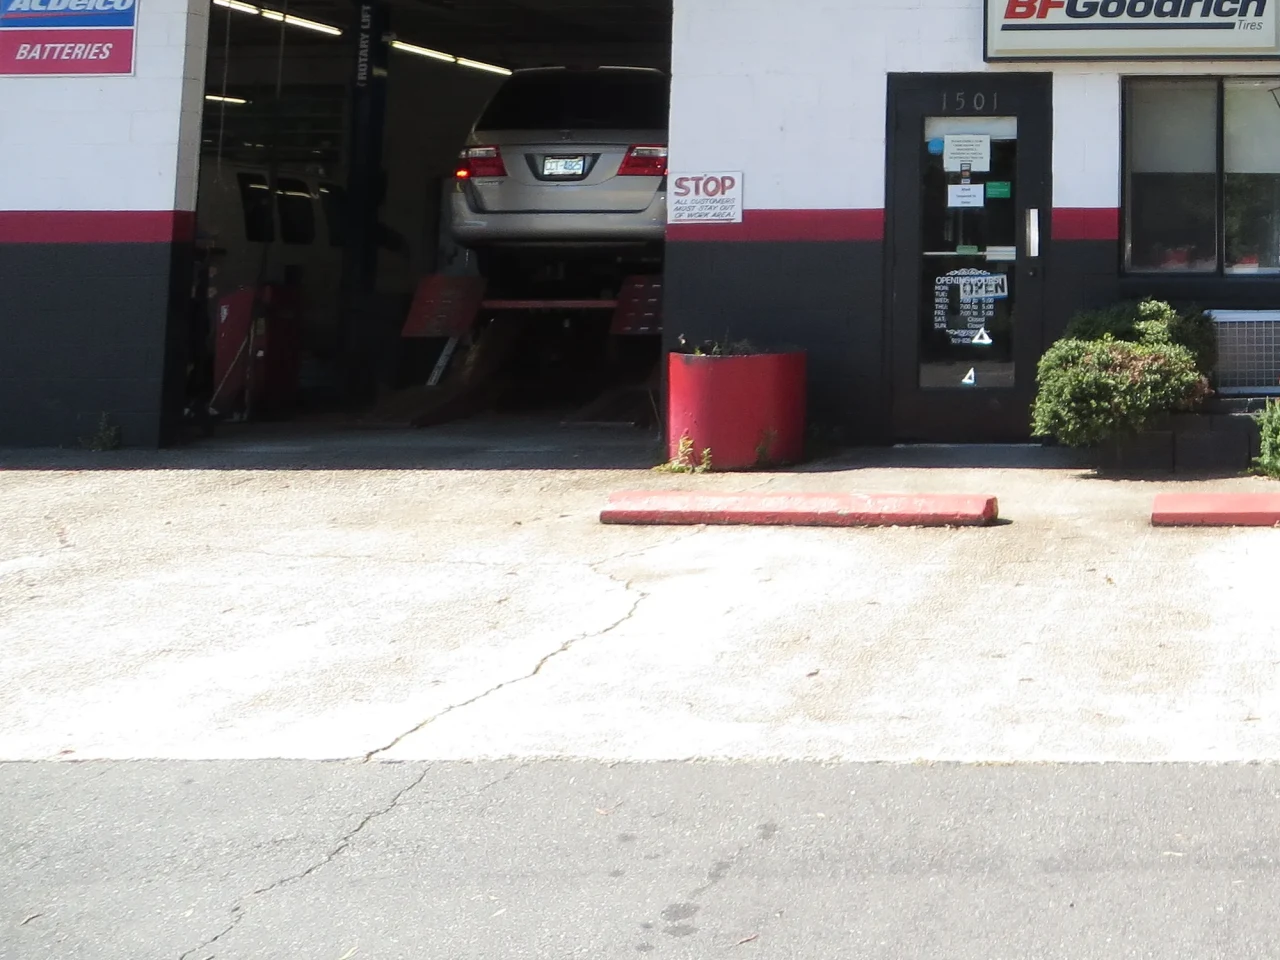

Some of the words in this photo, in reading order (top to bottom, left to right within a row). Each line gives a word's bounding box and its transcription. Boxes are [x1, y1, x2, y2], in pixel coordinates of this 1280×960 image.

[1237, 20, 1263, 30] Tires
[15, 43, 113, 60] BATTERIES
[942, 91, 998, 111] 1501
[674, 176, 736, 196] STOP
[935, 276, 970, 285] OPENING
[962, 277, 1006, 295] OPEN
